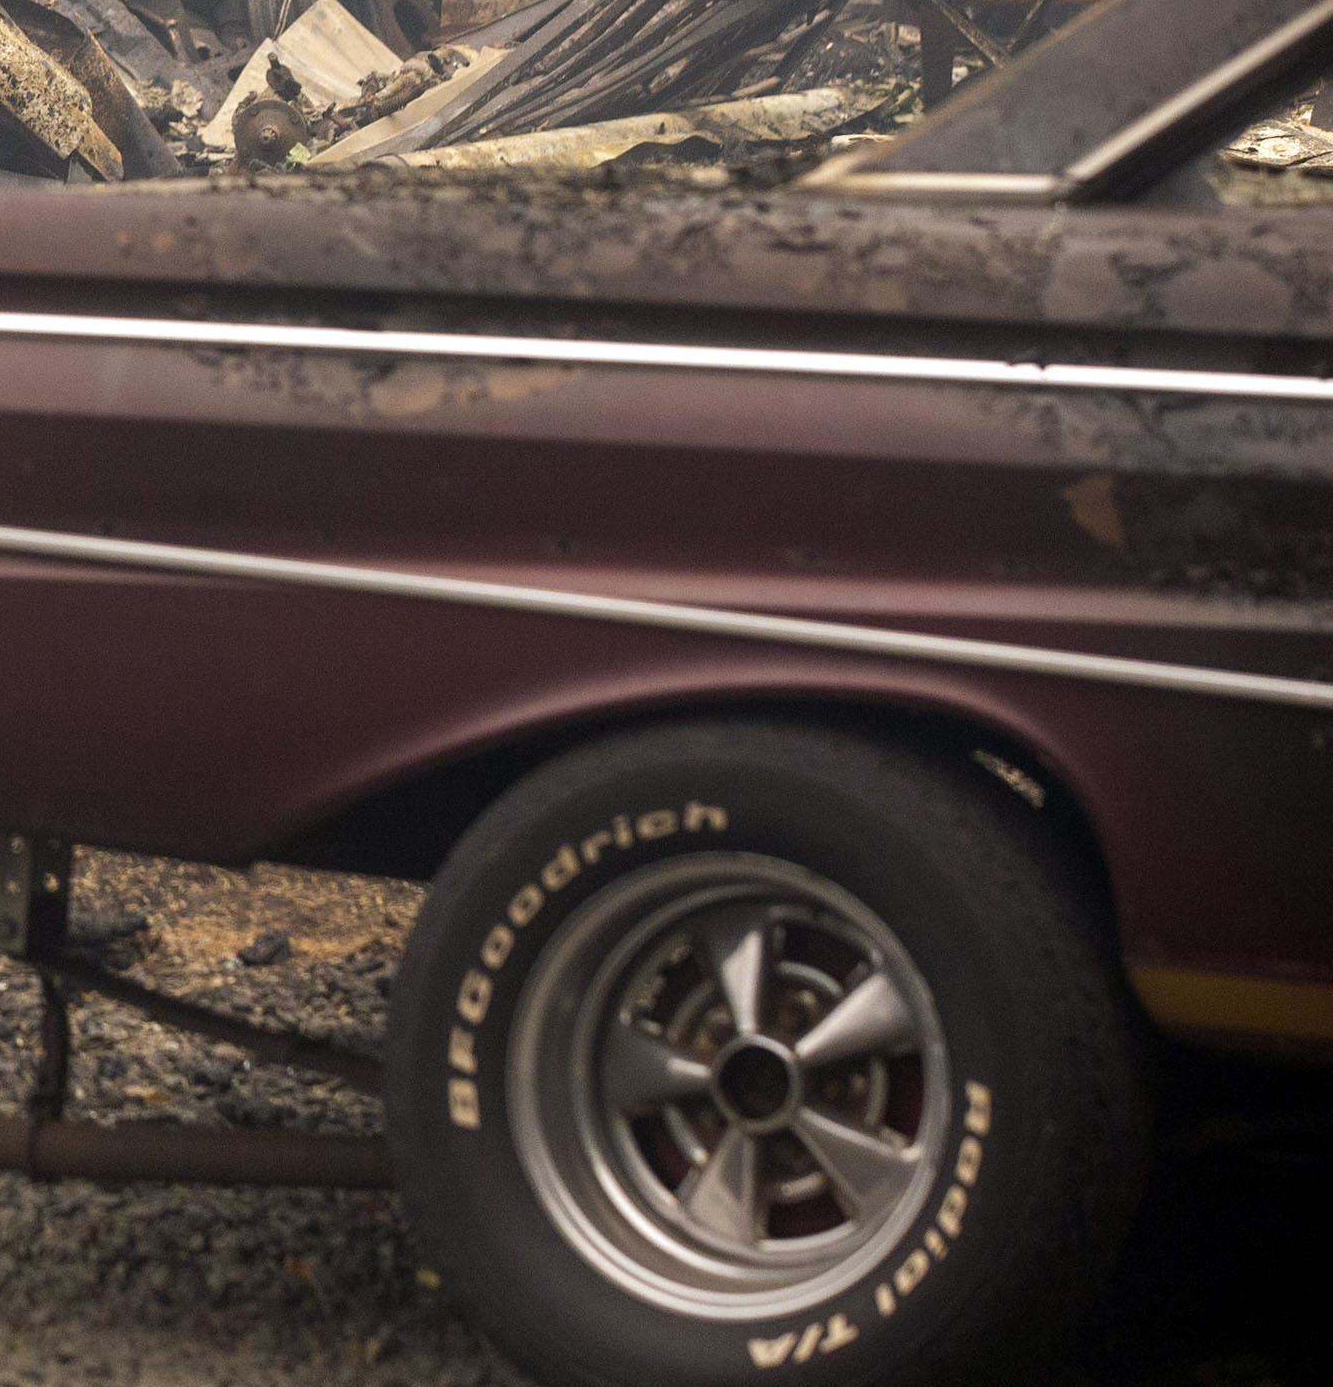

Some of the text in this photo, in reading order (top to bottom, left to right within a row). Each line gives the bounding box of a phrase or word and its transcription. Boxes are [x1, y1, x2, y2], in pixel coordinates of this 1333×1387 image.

[446, 799, 729, 1131] BFGoodrich
[746, 1077, 993, 1369] Radial T/A
